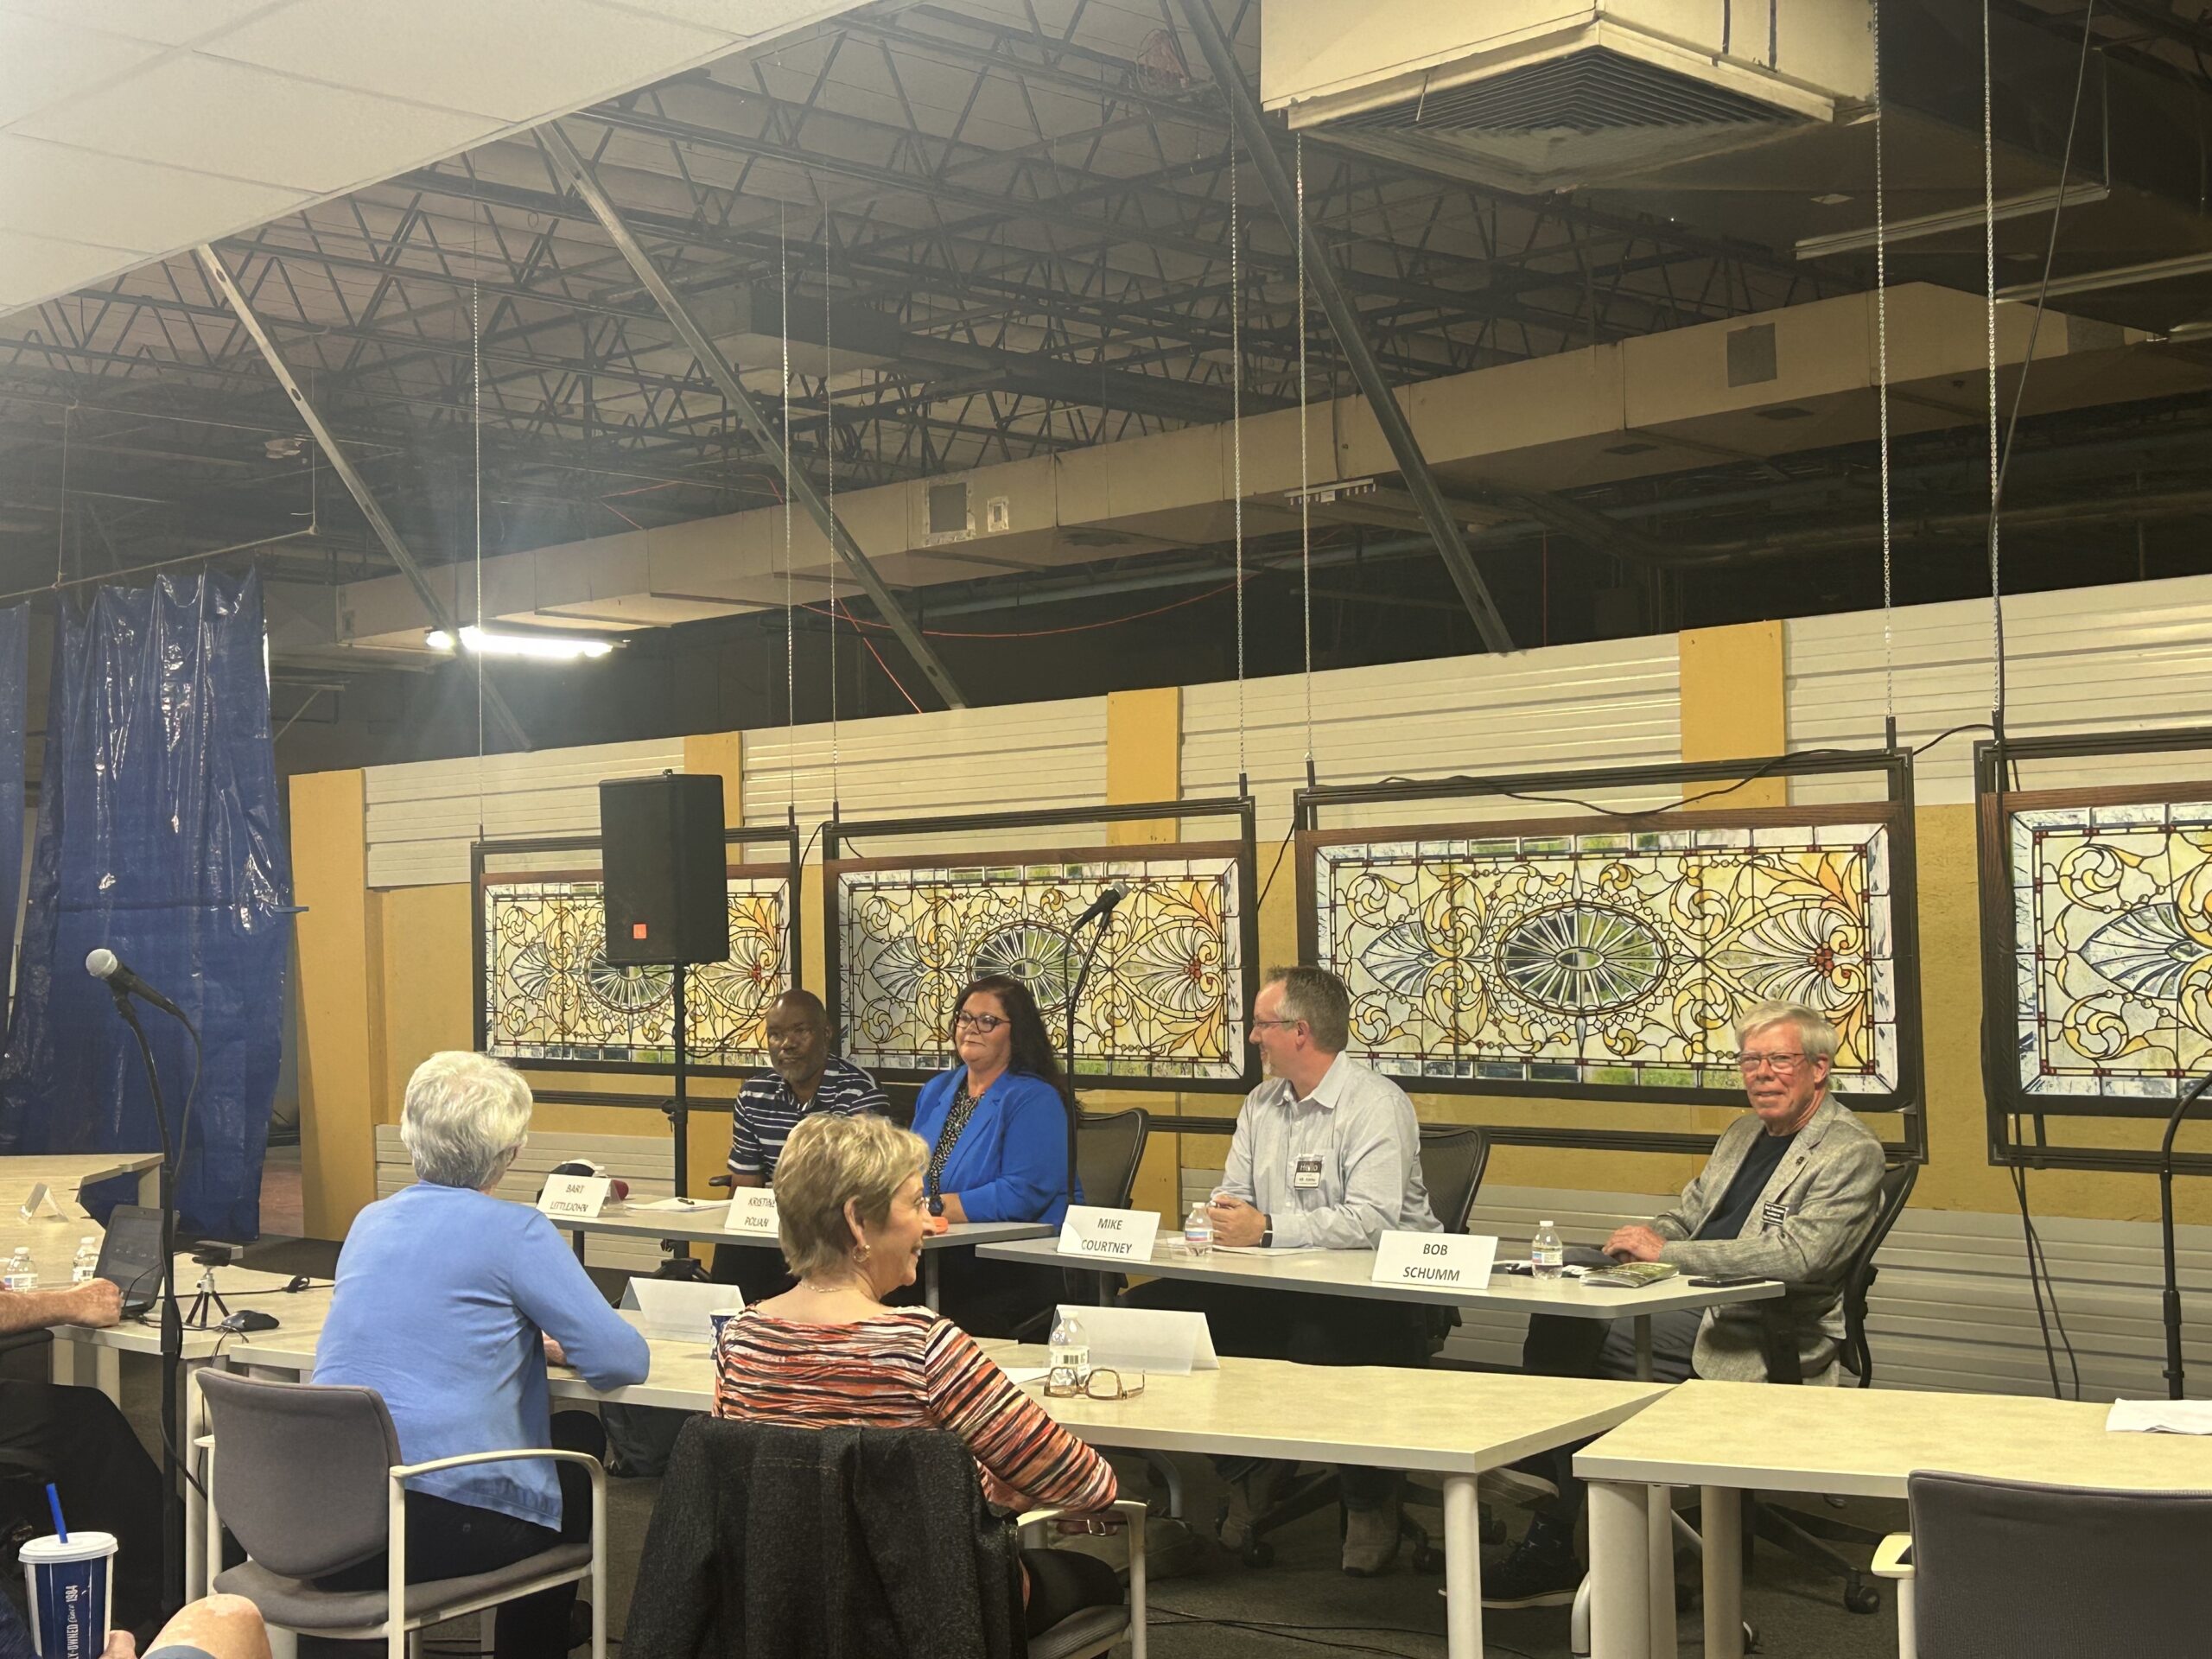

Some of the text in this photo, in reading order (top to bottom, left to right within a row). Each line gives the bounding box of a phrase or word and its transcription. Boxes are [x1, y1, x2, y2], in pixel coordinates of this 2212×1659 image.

[565, 1184, 585, 1193] BART
[1097, 1217, 1123, 1230] MIKE
[1081, 1239, 1133, 1254] COURTNEY
[1422, 1243, 1448, 1255] BOB
[1402, 1267, 1460, 1281] SCHUMM
[65, 1585, 78, 1603] 1984
